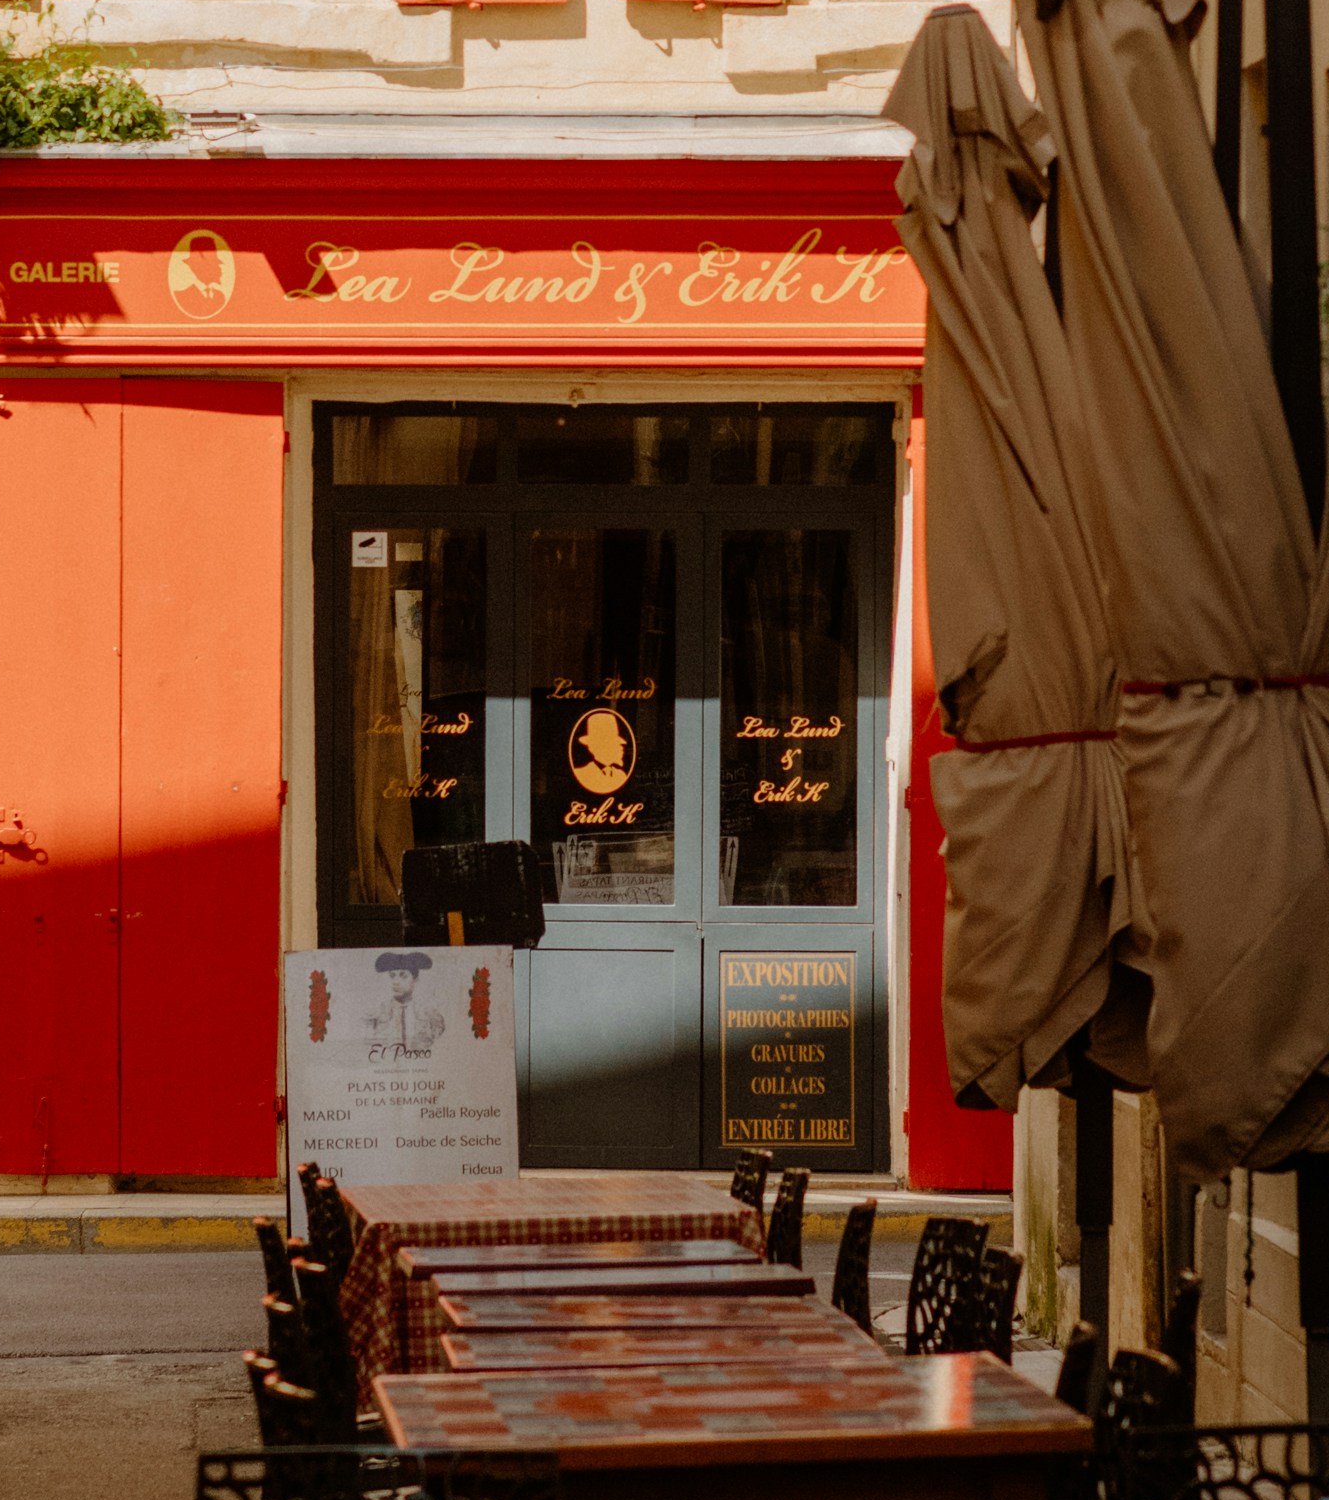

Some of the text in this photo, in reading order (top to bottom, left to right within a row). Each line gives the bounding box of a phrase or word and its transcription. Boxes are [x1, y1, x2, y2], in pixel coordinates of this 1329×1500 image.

[10, 228, 909, 324] GALERIE Lea Lund & Erik K
[547, 677, 658, 700] Lea Lund
[420, 712, 474, 735] Lund
[736, 715, 846, 739] Lea Lund
[780, 748, 801, 771] &
[425, 777, 457, 799] K
[753, 776, 829, 804] Erik K
[564, 797, 644, 826] Erik K
[727, 961, 849, 987] EXPOSITION
[727, 1009, 849, 1028] PHOTOGRAPHIES
[368, 1042, 432, 1063] El Paseo
[751, 1044, 825, 1063] GRAVURES
[347, 1080, 446, 1093] PLATS DU JOUR
[751, 1076, 826, 1095] COLLAGES
[355, 1096, 439, 1107] DE LA SEMAINE
[303, 1109, 351, 1122] MARDI
[420, 1106, 501, 1121] Paëlla Royale
[727, 1113, 850, 1141] ENTRÉE LIBRE
[304, 1137, 378, 1150] MERCREDI
[396, 1134, 502, 1148] Daube de Seiche
[461, 1163, 503, 1175] Fideua
